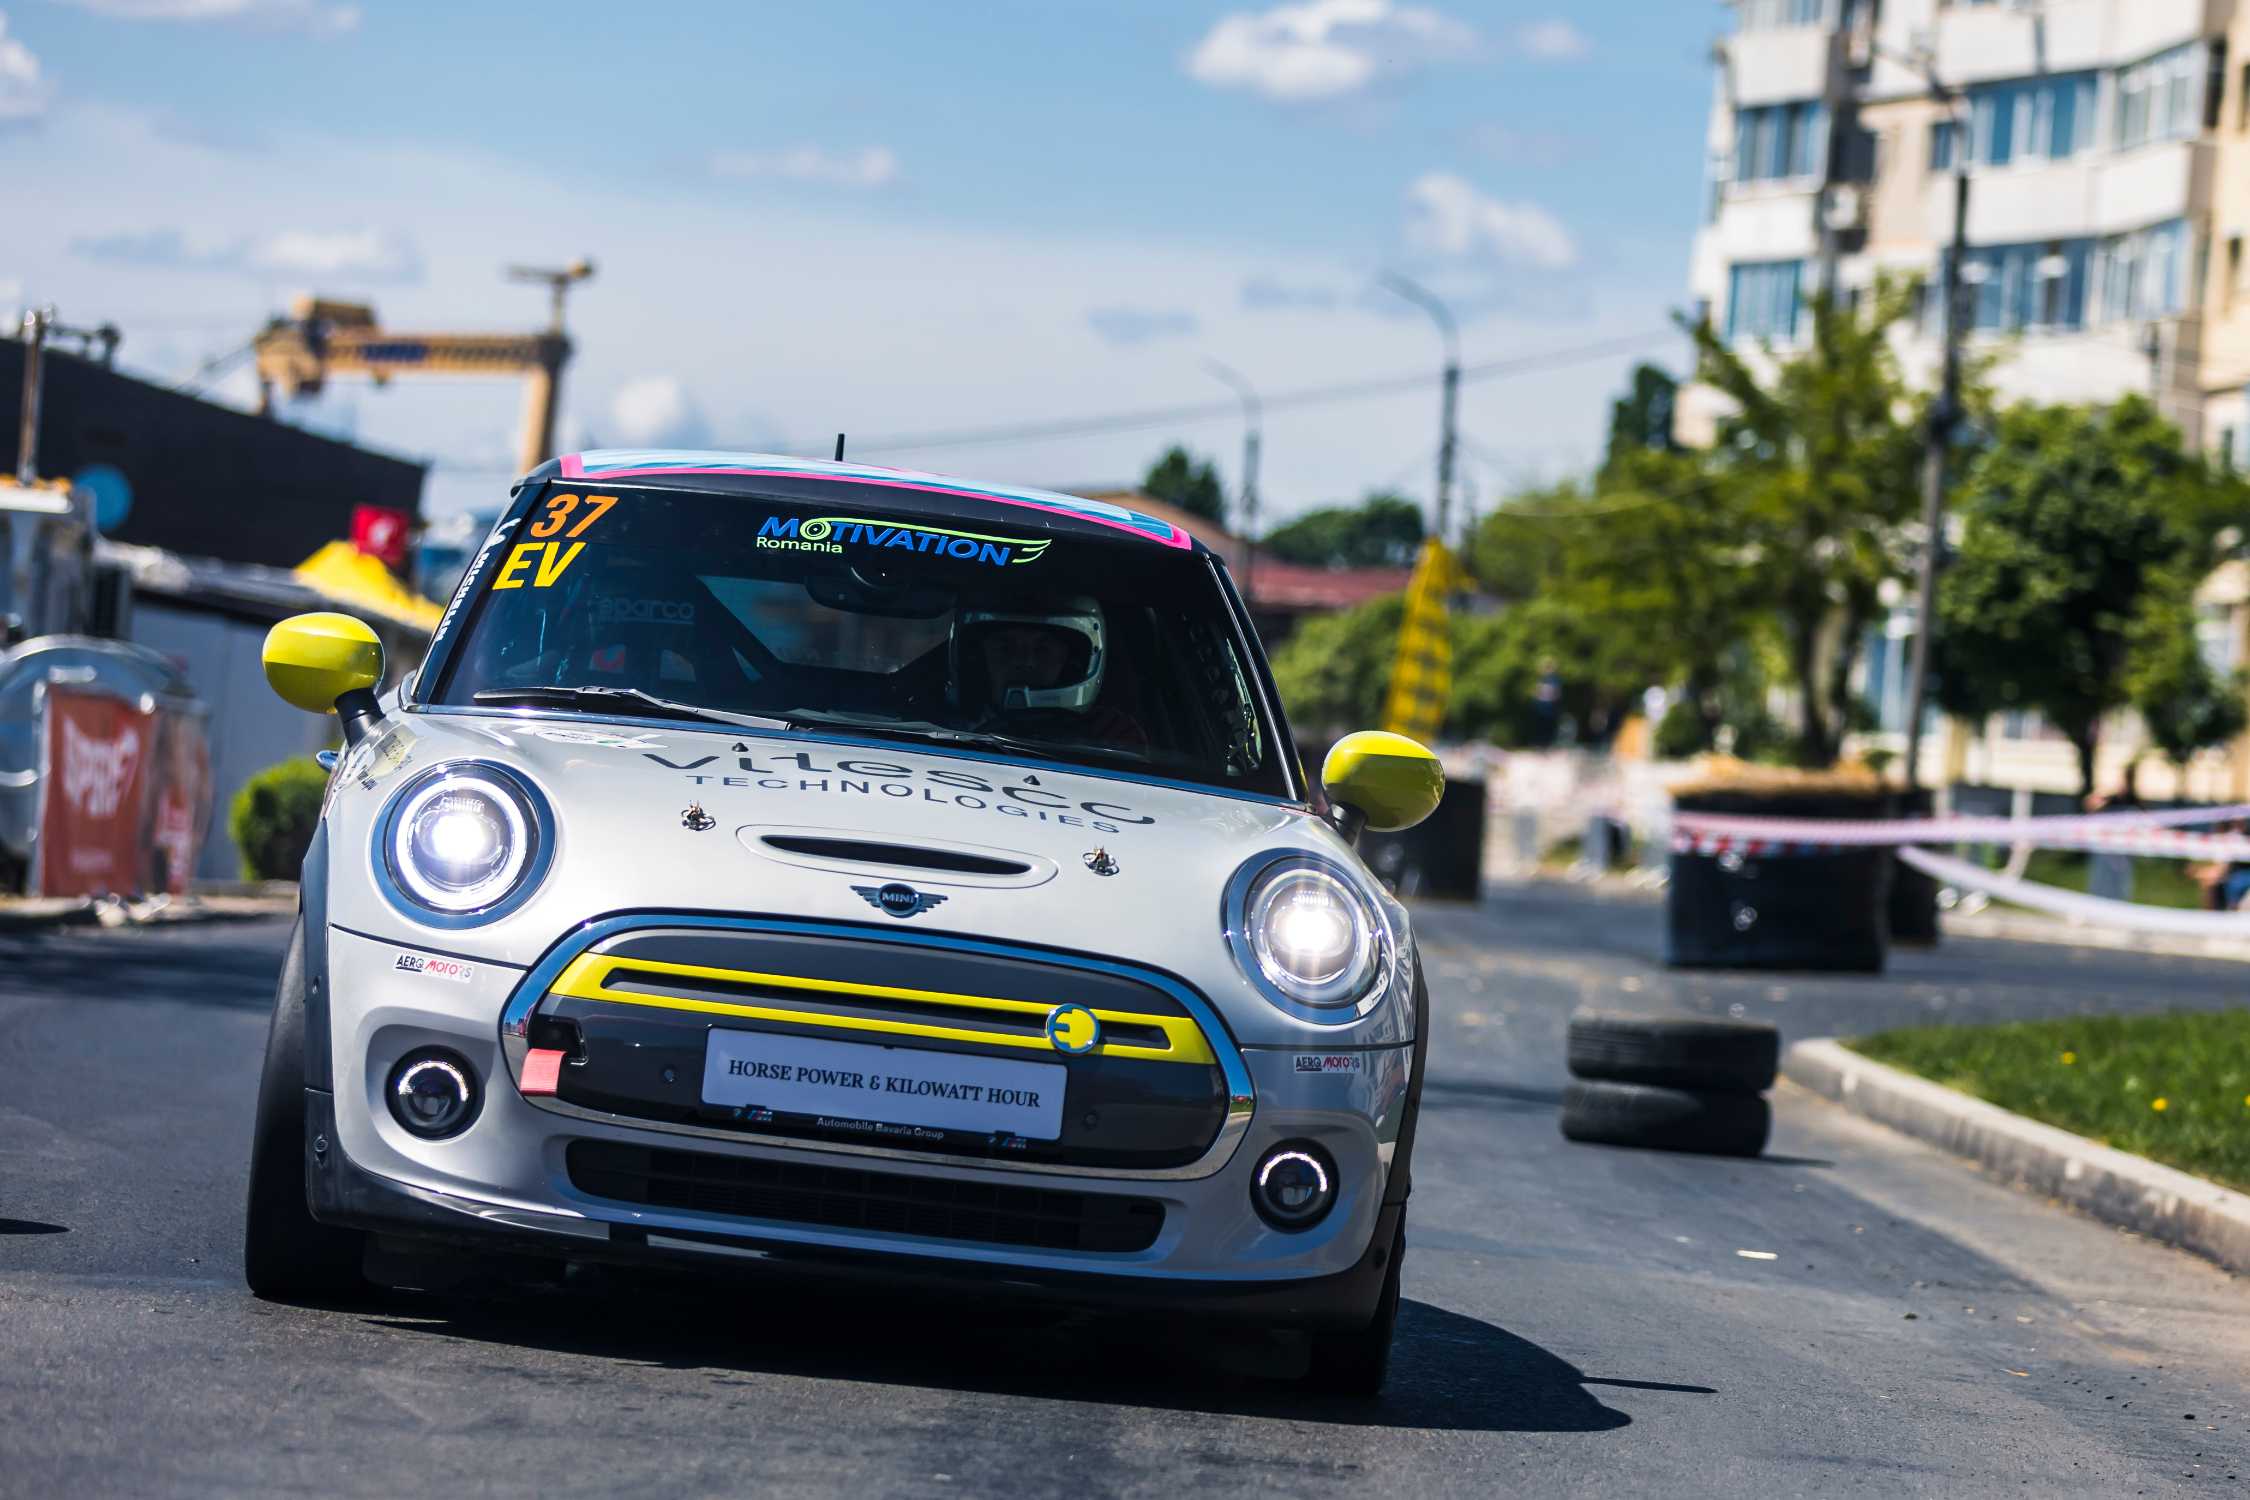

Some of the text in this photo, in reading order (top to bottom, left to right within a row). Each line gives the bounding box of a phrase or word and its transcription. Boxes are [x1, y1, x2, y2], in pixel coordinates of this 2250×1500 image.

[529, 493, 620, 539] 37
[755, 535, 844, 555] Romania
[756, 515, 1013, 567] MOTIVATION
[491, 541, 588, 591] EV
[685, 774, 1121, 834] TECHNOLOGIES
[881, 891, 915, 905] MINI
[728, 1058, 1041, 1108] HORSE POWER & KILOWATT HOUR
[816, 1116, 874, 1132] Automobile
[913, 1126, 945, 1141] Group
